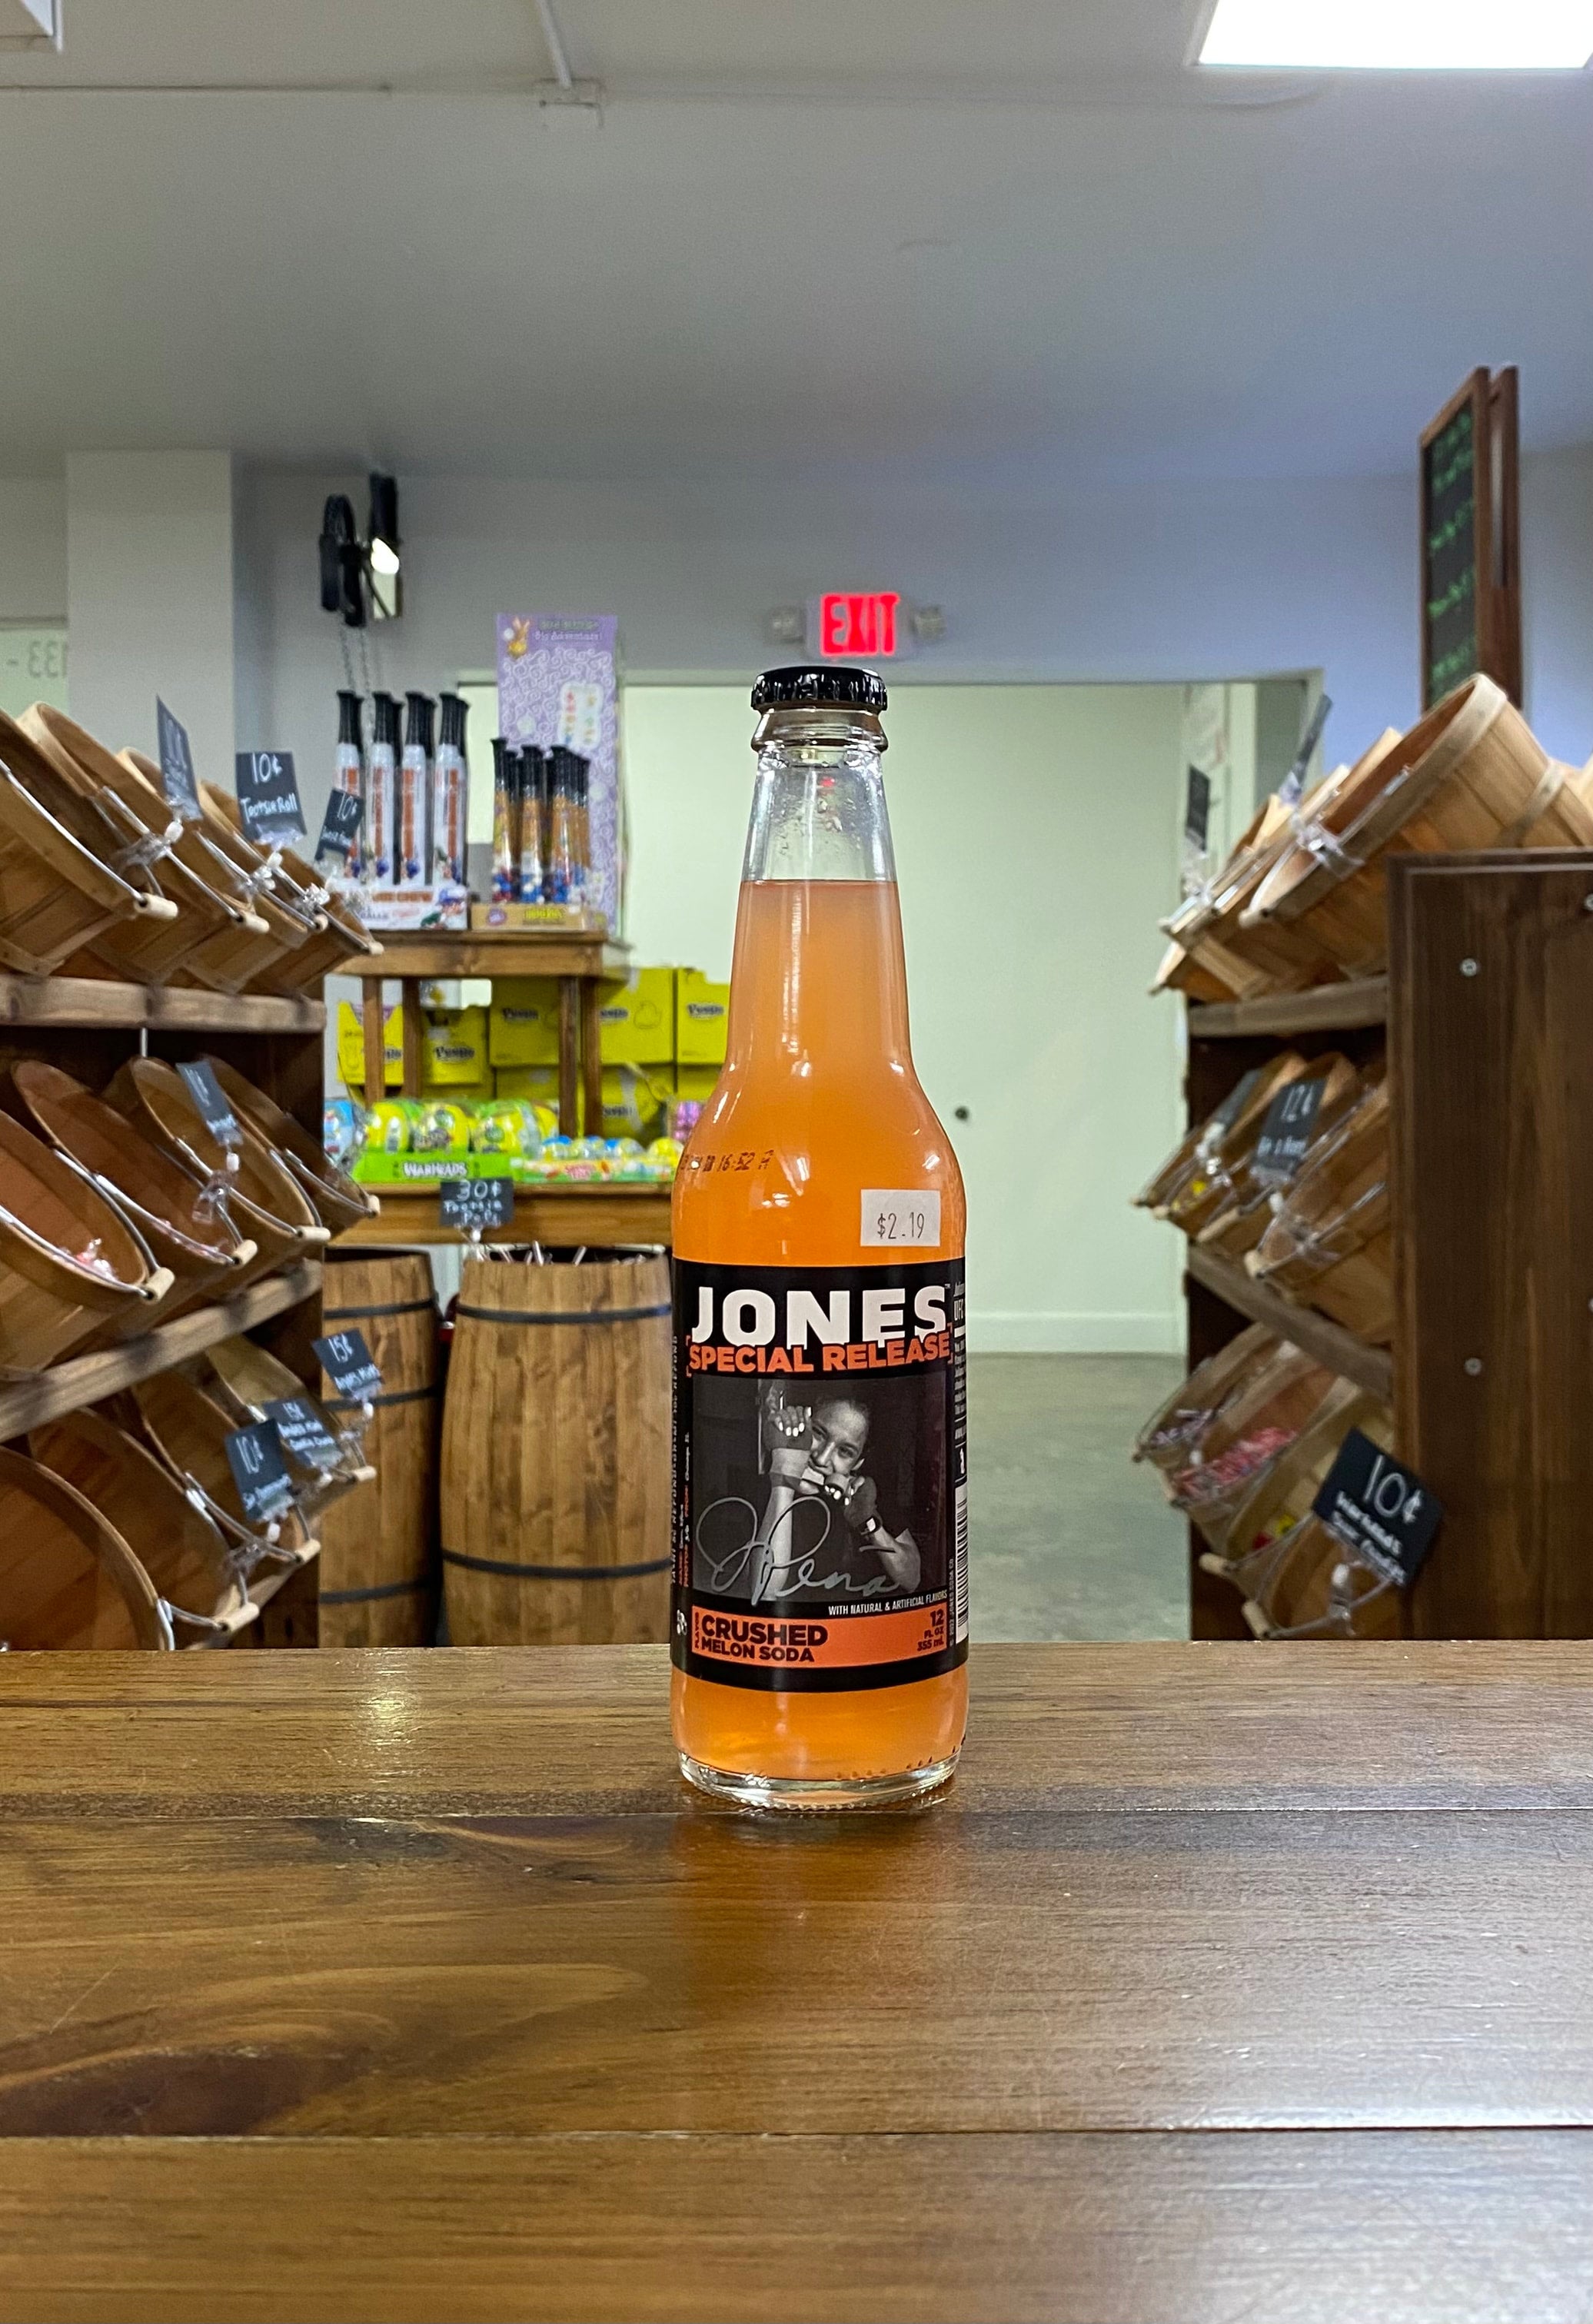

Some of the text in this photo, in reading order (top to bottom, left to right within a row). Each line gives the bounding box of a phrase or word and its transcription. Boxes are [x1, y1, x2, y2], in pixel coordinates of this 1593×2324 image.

[820, 592, 900, 656] EXIT
[877, 1212, 925, 1239] $2.19
[692, 1285, 946, 1350] JONES
[690, 1332, 951, 1373] SPECIAL RELEASE
[828, 1605, 848, 1615] WITH
[850, 1603, 882, 1614] NATURAL
[885, 1601, 890, 1611] &
[892, 1596, 925, 1610] ARTIFICIAL
[930, 1609, 945, 1627] 12
[701, 1614, 828, 1646] CRUSHED
[701, 1637, 815, 1662] MELON SODA
[917, 1640, 933, 1651] 355
